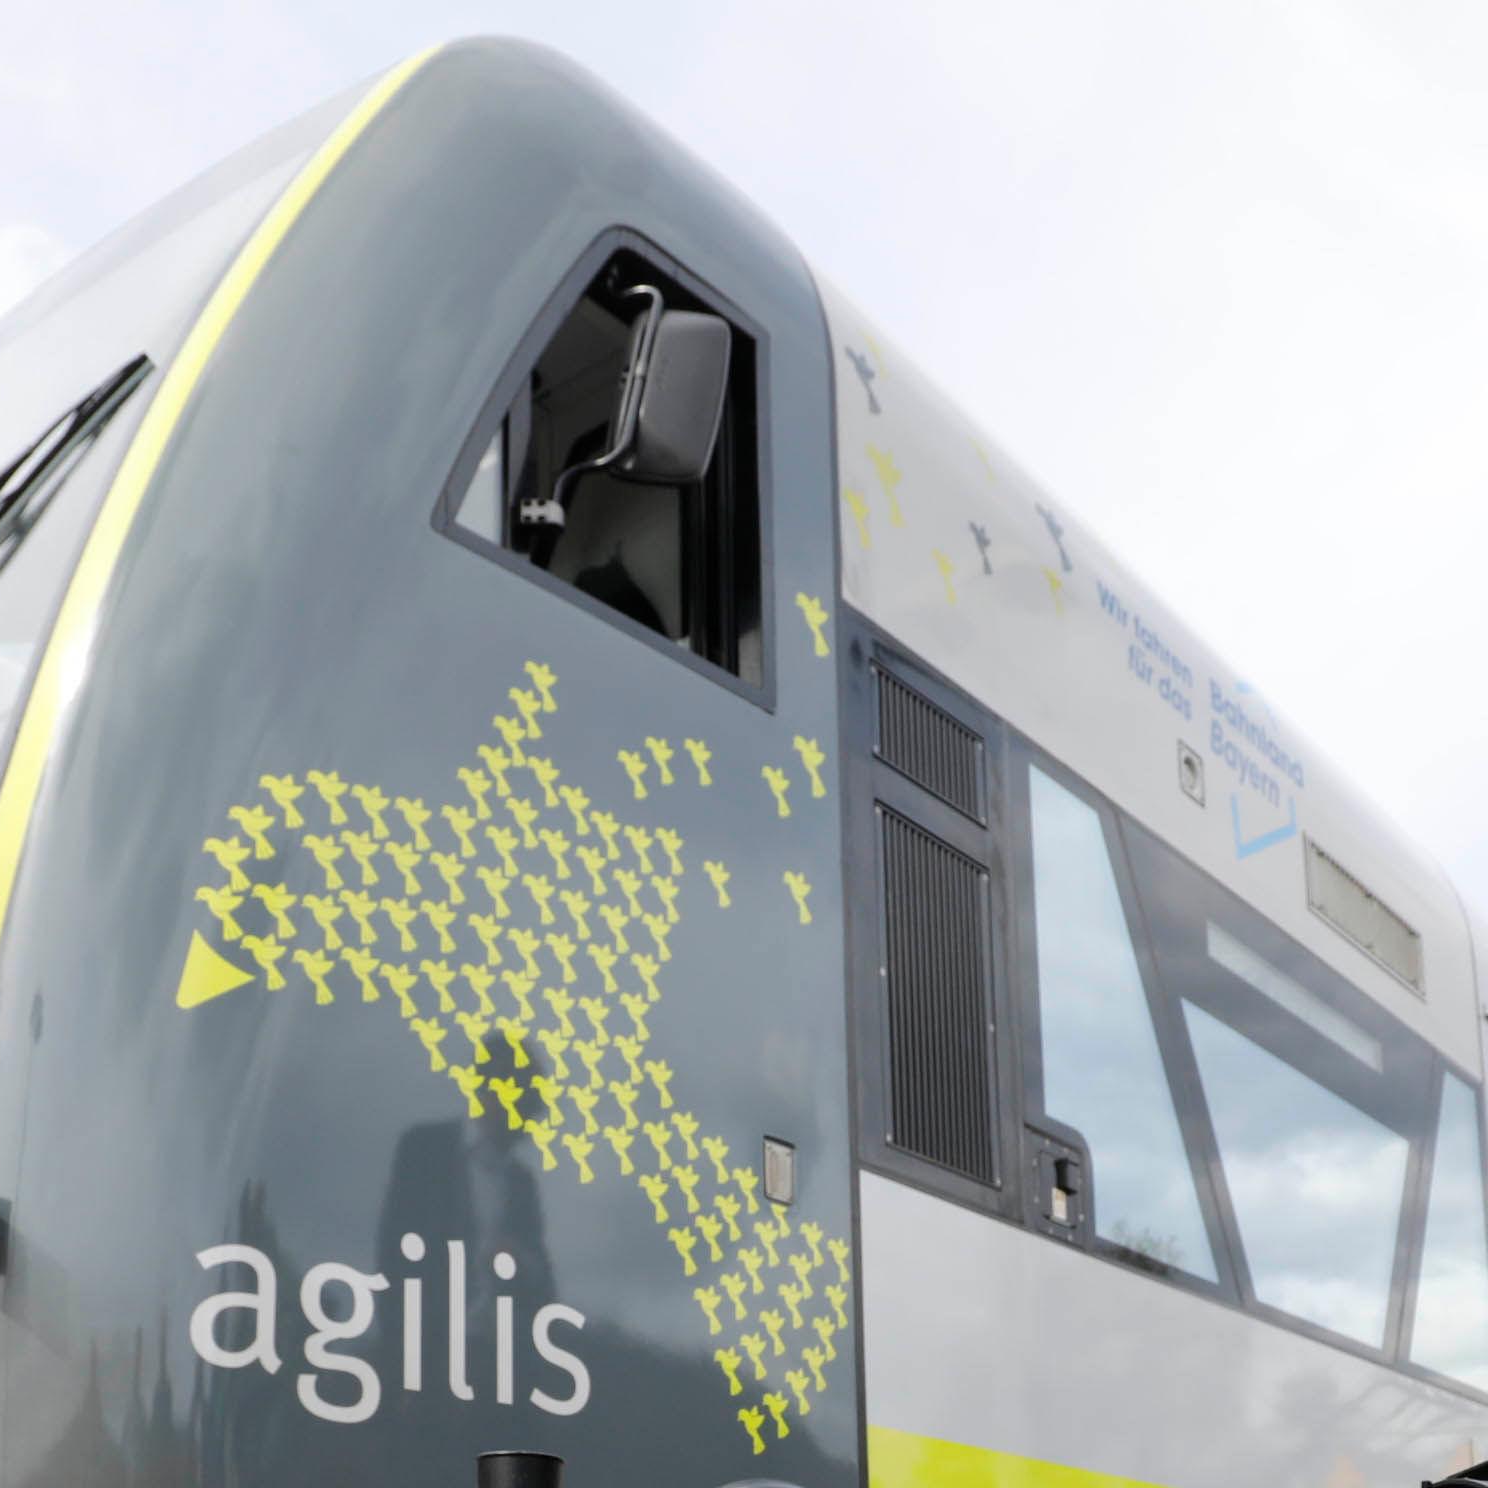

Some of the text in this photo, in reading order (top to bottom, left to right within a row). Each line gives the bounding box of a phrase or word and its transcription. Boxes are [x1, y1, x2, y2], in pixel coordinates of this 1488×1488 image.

[1096, 579, 1193, 689] Wir fahren
[1128, 643, 1193, 722] für das
[1209, 676, 1305, 789] Bahnland
[1209, 719, 1280, 809] Bayern
[188, 1231, 592, 1424] agilis
